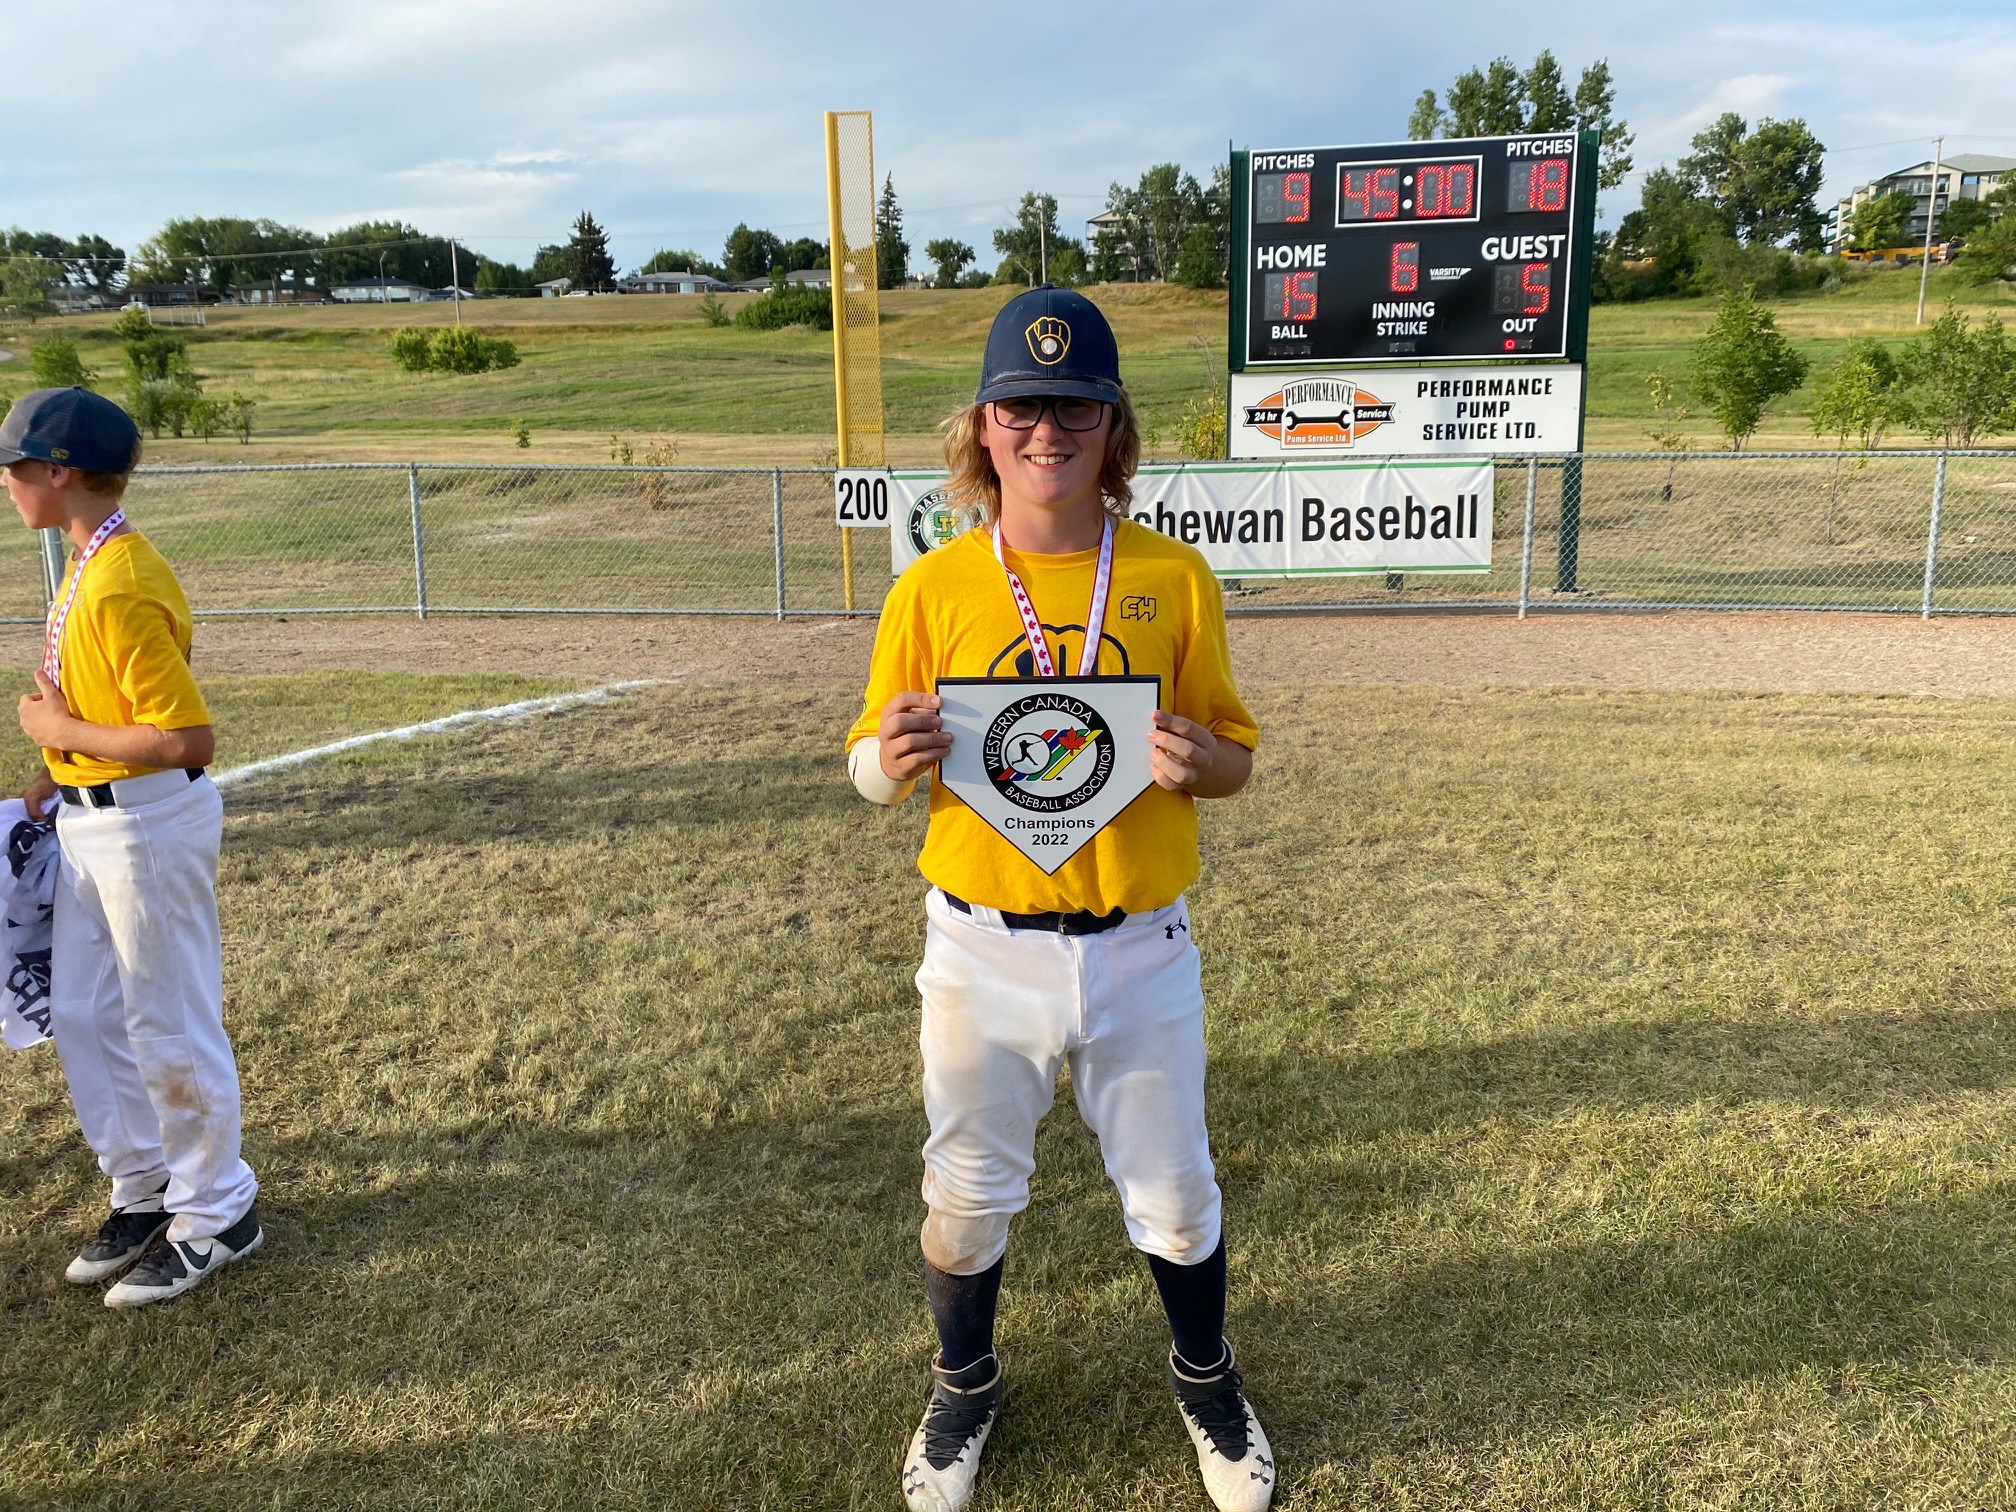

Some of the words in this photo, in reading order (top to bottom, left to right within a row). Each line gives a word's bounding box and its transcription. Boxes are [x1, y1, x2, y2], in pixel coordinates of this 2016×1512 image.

[1506, 138, 1573, 157] PITCHES
[1253, 153, 1315, 171] PITCHES
[1343, 162, 1475, 220] 45:00
[1528, 158, 1569, 212] 18
[1283, 171, 1311, 224] 9
[1256, 243, 1327, 270] HOME
[1481, 234, 1566, 261] GUEST
[1390, 241, 1418, 293] 6
[1429, 267, 1461, 277] VARSITY
[1282, 271, 1318, 321] 15
[1522, 262, 1550, 315] 5
[1372, 301, 1435, 320] INNING
[1271, 324, 1308, 340] BALL
[1376, 321, 1428, 336] STRIKE
[1502, 317, 1538, 333] OUT
[1284, 382, 1354, 407] PERFORMANCE
[1417, 377, 1553, 398] PERFORMANCE
[1254, 412, 1266, 421] 24
[1267, 411, 1278, 421] hr
[1357, 409, 1388, 419] Service
[1456, 401, 1511, 419] PUMP
[1286, 435, 1306, 444] Pump
[1307, 434, 1334, 443] Service
[1335, 433, 1349, 442] Ltd.
[1423, 421, 1498, 441] SERVICE
[1505, 421, 1543, 439] LTD.
[838, 478, 888, 522] 200
[1301, 494, 1478, 542] Baseball
[986, 706, 1020, 770] WESTERN
[1020, 696, 1093, 724] CANADA
[1005, 785, 1061, 810] BASEBALL
[1065, 744, 1111, 807] ASSOCIATION
[1004, 817, 1096, 832] Champions
[1031, 833, 1069, 846] 2022
